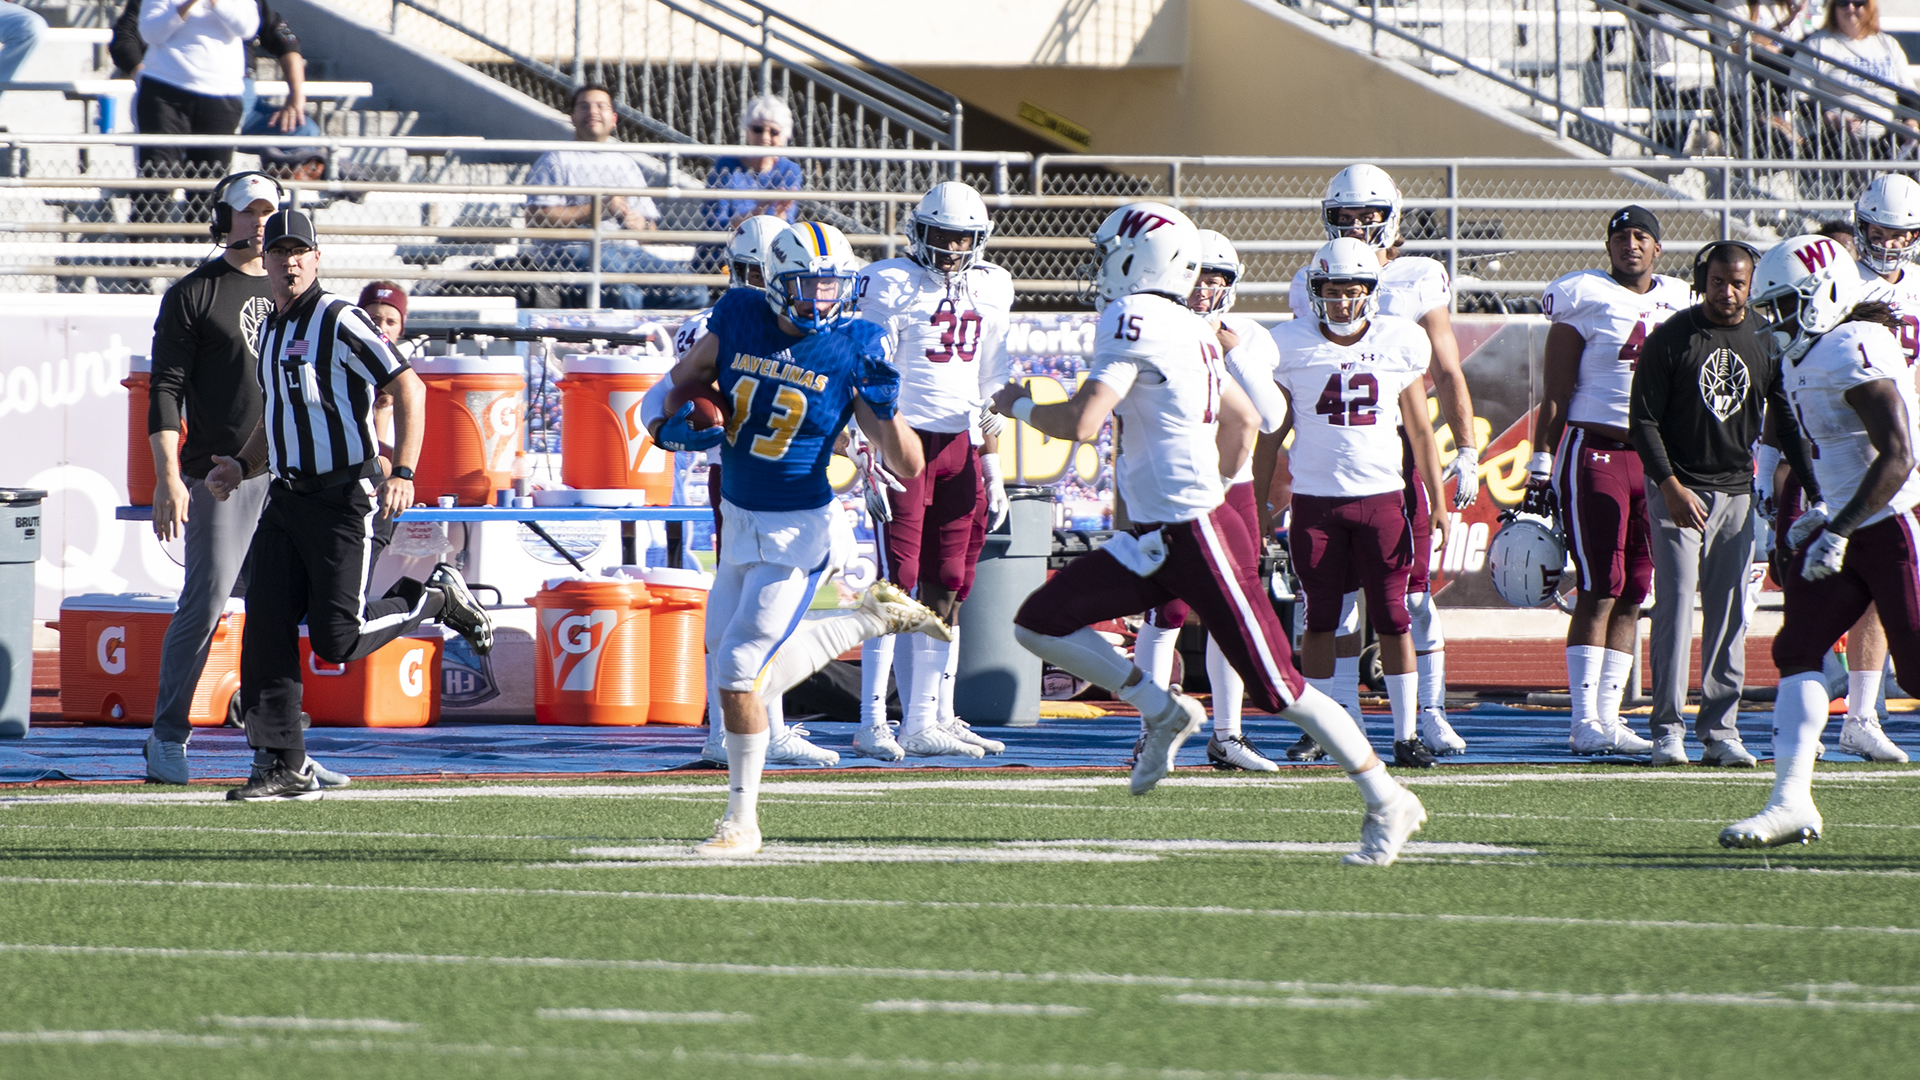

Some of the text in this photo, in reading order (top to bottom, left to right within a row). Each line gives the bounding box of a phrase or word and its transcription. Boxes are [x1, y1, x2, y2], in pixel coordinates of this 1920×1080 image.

[1117, 209, 1176, 238] WT
[677, 328, 697, 353] 24
[925, 309, 983, 363] 30
[1114, 313, 1144, 342] 15
[1618, 320, 1658, 372] 4
[730, 352, 829, 393] JAVELINAS
[1858, 342, 1872, 368] 1
[287, 371, 299, 388] L
[1315, 372, 1379, 426] 42
[726, 375, 808, 462] 13
[15, 516, 40, 528] BRUTE
[97, 626, 126, 674] G
[559, 616, 591, 654] G
[400, 648, 423, 697] G
